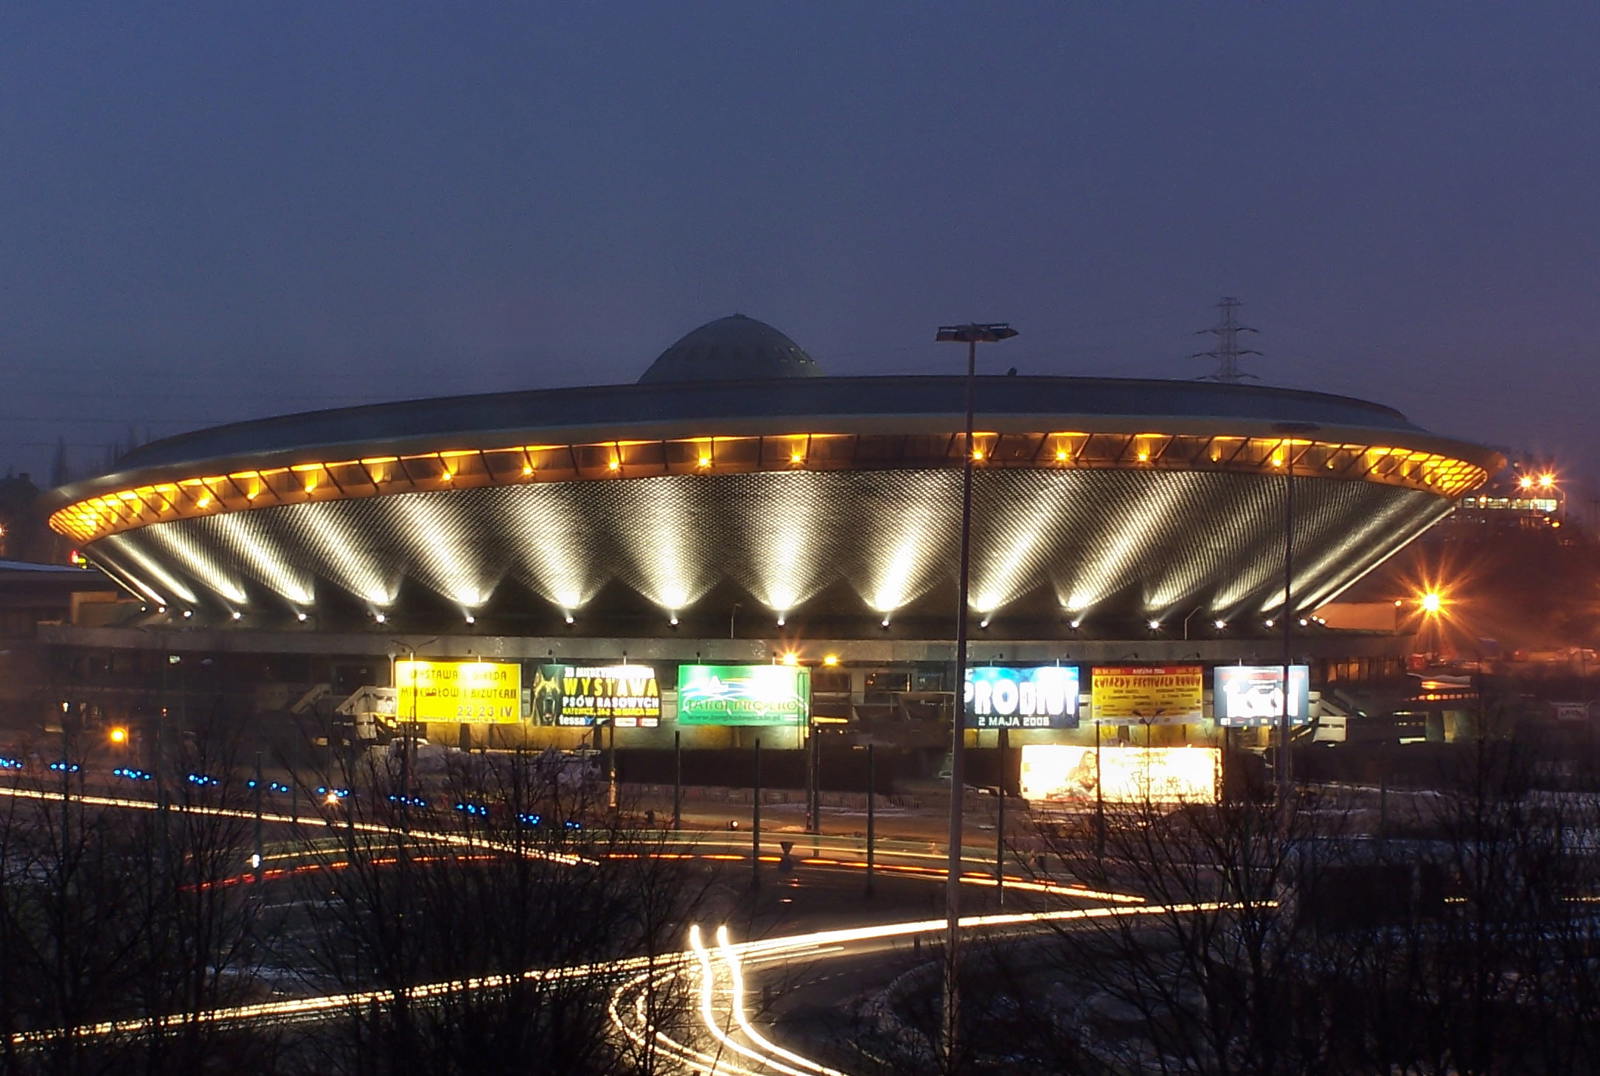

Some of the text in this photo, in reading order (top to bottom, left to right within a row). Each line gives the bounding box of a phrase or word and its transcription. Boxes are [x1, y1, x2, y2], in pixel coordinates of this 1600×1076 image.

[563, 678, 659, 696] WYSTAWA
[562, 695, 659, 708] PSÓW RASOWYCH
[500, 706, 513, 717] IV
[978, 716, 986, 726] 2
[989, 716, 1020, 726] MAJA
